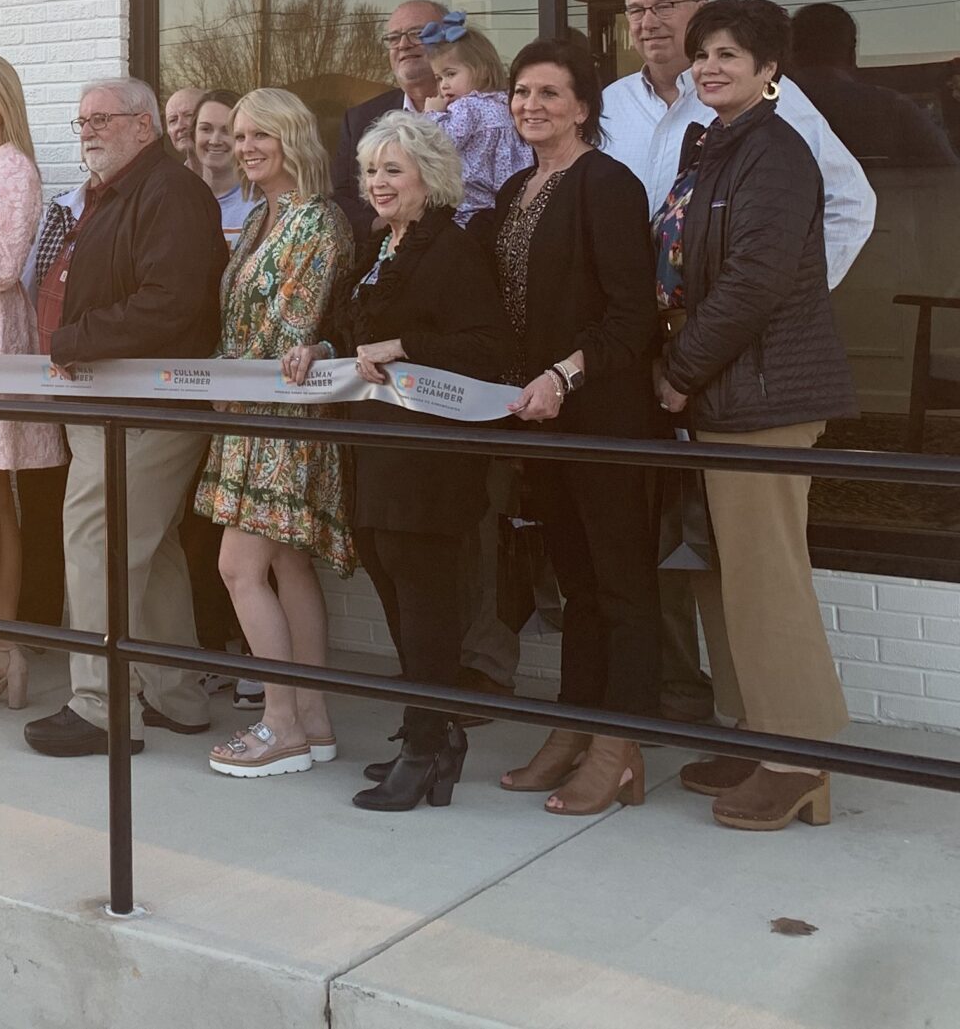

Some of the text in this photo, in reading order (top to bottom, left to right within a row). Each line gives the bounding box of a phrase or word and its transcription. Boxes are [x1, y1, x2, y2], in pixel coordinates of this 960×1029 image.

[174, 369, 211, 377] CULLMAN
[174, 377, 211, 385] CHAMBER
[418, 377, 465, 395] CULLMAN
[416, 385, 463, 403] CHAMBER
